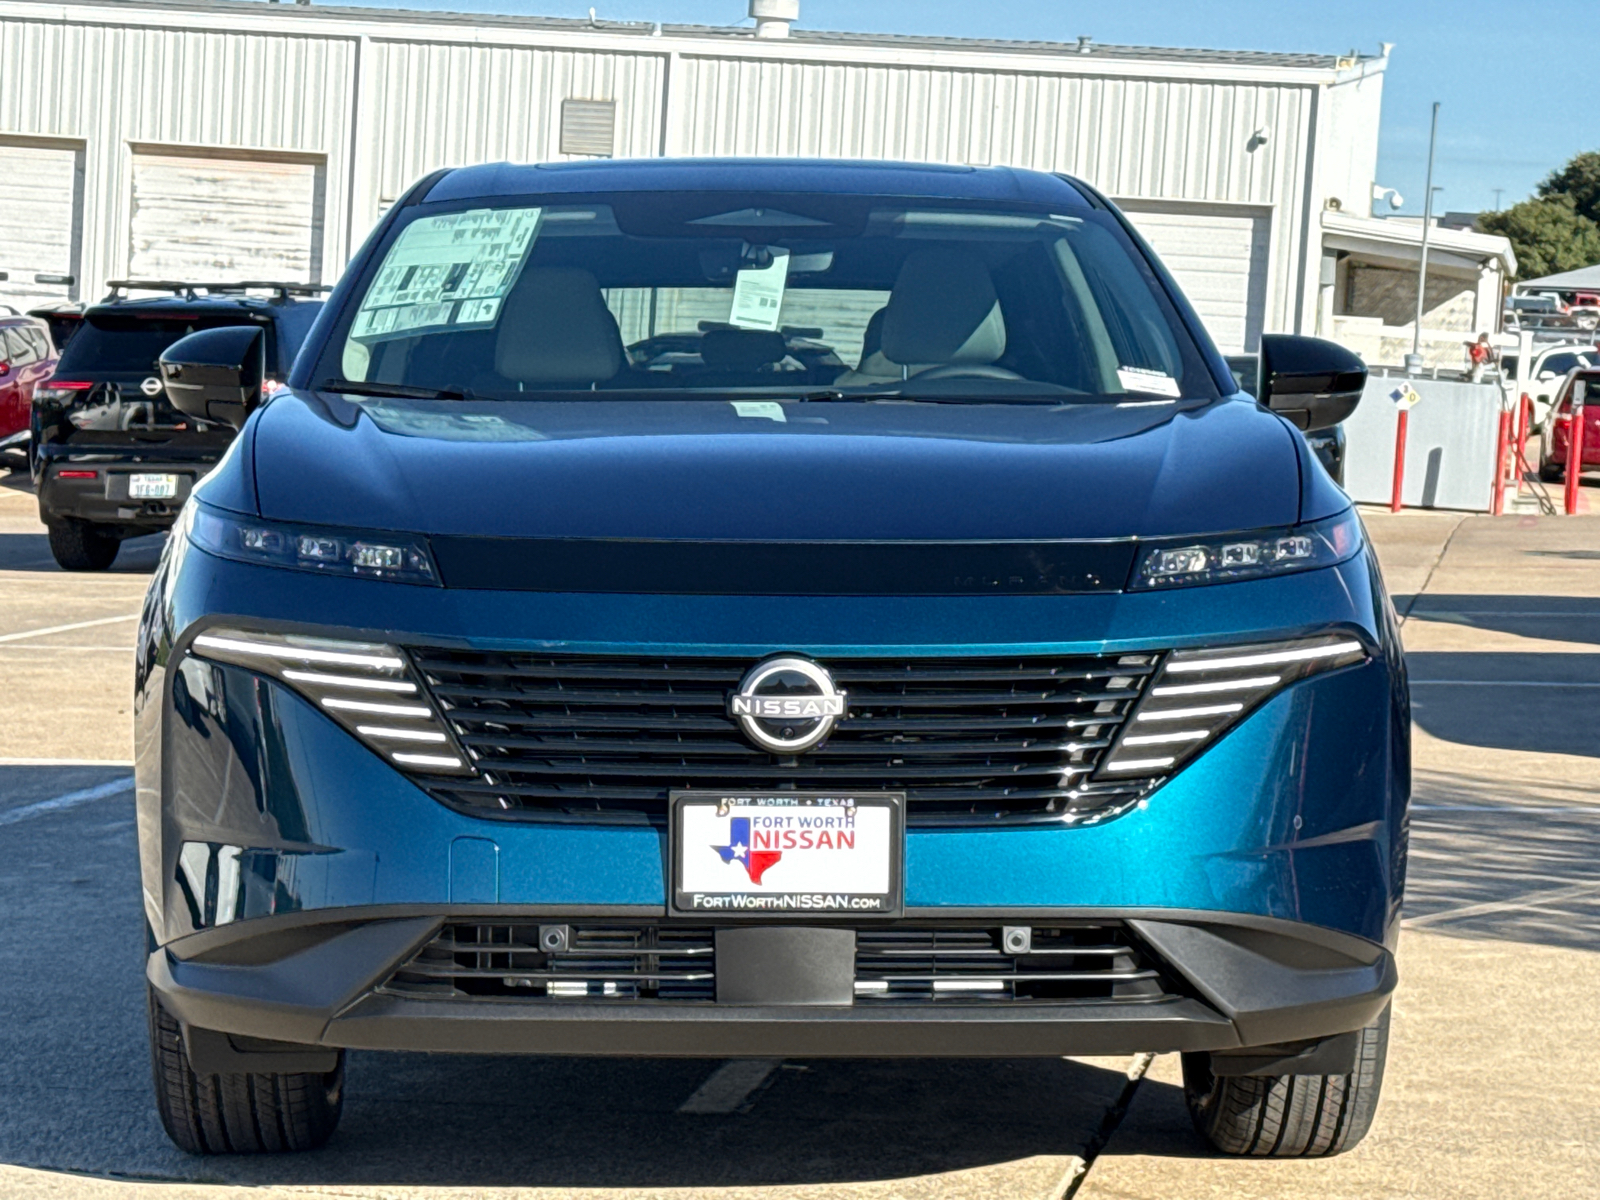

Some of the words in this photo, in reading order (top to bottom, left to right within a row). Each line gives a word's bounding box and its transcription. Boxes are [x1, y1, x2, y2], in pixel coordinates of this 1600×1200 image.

[734, 698, 840, 715] NISSAN
[721, 798, 752, 806] FORT
[757, 798, 798, 806] WORTH
[753, 816, 793, 828] FORT
[797, 816, 855, 828] WORTH
[753, 830, 855, 850] NISSAN
